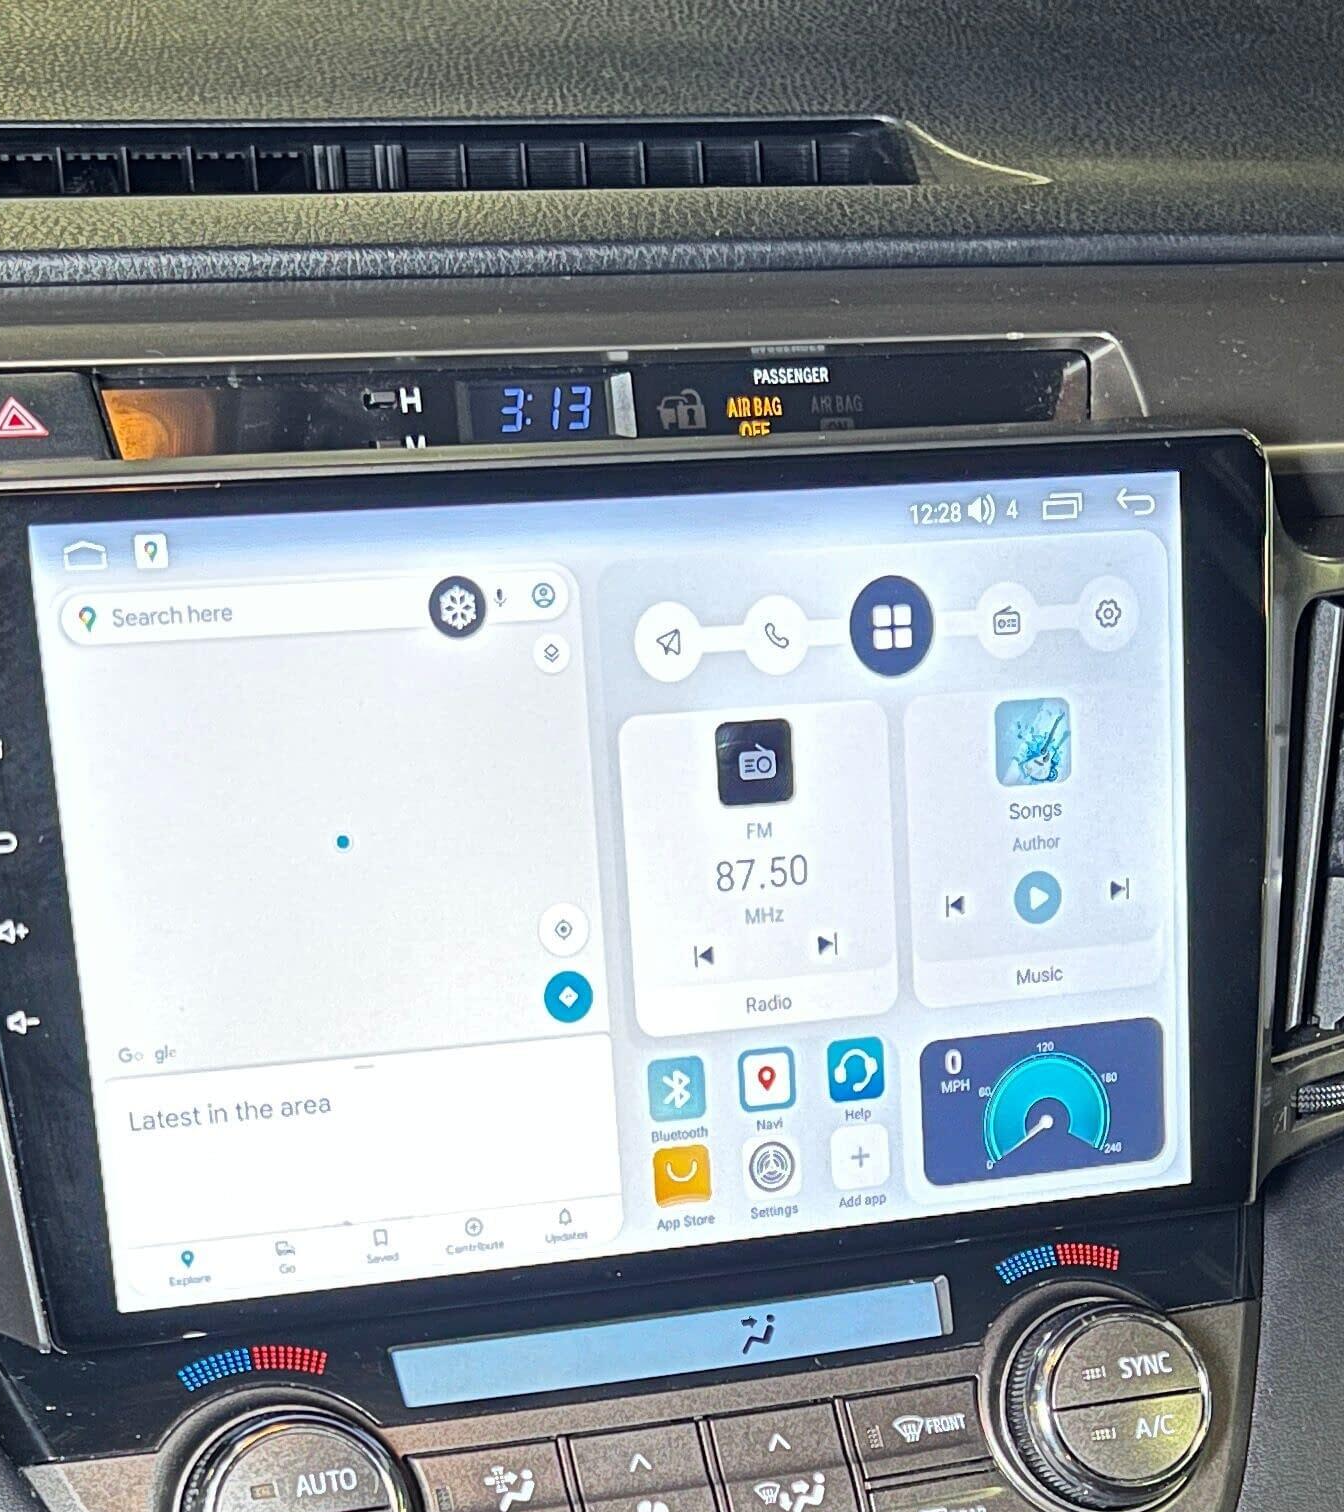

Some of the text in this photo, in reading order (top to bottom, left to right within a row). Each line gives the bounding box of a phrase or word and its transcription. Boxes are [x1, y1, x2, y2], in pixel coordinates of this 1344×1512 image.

[753, 367, 829, 385] PASSENGER
[399, 387, 423, 414] H
[501, 385, 592, 432] 3:13
[727, 396, 783, 418] AIR BAG
[910, 501, 962, 525] 12:28
[1006, 499, 1018, 519] 4
[112, 603, 233, 628] Search here
[1009, 801, 1063, 821] Songs
[746, 822, 773, 839] FM
[1012, 835, 1061, 852] Author
[716, 854, 809, 892] 87.50
[744, 906, 785, 925] MHz
[1016, 966, 1064, 986] Music
[746, 993, 793, 1014] Radio
[1036, 1041, 1055, 1052] 120
[944, 1048, 963, 1075] 0
[941, 1078, 971, 1094] MPH
[128, 1096, 332, 1132] Latest in the area
[845, 1107, 872, 1121] Help
[651, 1126, 709, 1143] Bluetooth
[756, 1119, 784, 1131] Navi
[1104, 1142, 1122, 1154] 240
[839, 1193, 887, 1208] Add app
[750, 1203, 799, 1220] Settings
[657, 1213, 716, 1231] App Store
[445, 1239, 505, 1255] Contribute
[366, 1252, 400, 1264] Saved
[279, 1263, 296, 1274] Go
[168, 1273, 212, 1287] Explore
[1118, 1351, 1173, 1379] SYNC
[925, 1413, 966, 1435] FRONT
[1136, 1414, 1175, 1440] A/C
[296, 1467, 358, 1498] AUTO
